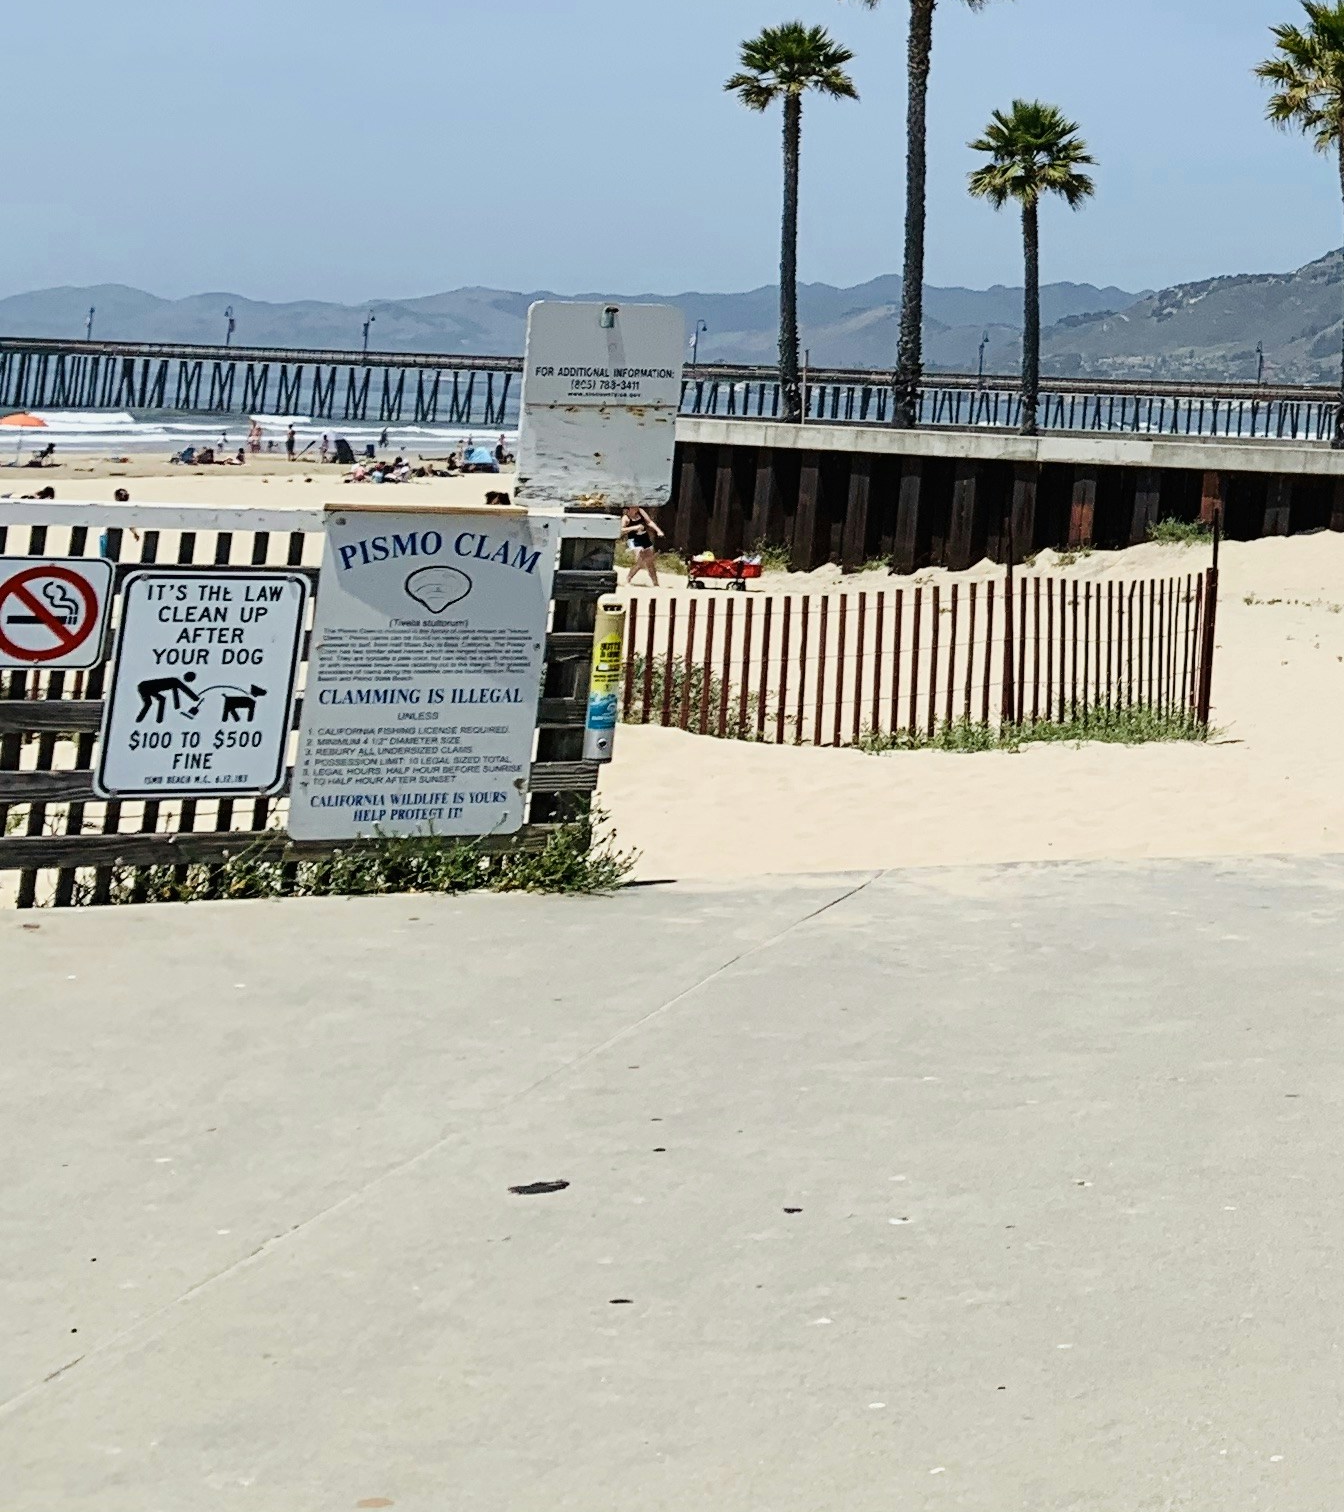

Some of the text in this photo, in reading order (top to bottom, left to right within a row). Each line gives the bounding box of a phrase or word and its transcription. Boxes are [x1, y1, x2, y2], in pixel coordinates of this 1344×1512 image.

[536, 367, 675, 379] FOR ADDITIONAL INFORMATION:
[571, 379, 595, 390] (805)
[338, 531, 543, 574] PISMO CLAM
[148, 585, 283, 602] IT'S THE LAW
[159, 606, 268, 623] CLEAN UP
[176, 628, 244, 644] AFTER
[153, 649, 264, 665] YOUR DOG
[319, 688, 523, 704] CLAMMING IS ILLEGAL
[378, 727, 415, 735] FISHING
[418, 726, 458, 734] LICENSE
[129, 729, 262, 751] $100 TO $500
[390, 737, 438, 745] DIAMETER
[316, 748, 355, 756] REBURY
[359, 748, 375, 756] ALL
[378, 747, 438, 755] UNDERSIZED
[173, 754, 214, 769] FINE
[421, 757, 450, 765] LEGAL
[443, 766, 481, 774] BEFORE
[483, 765, 522, 773] SUNRISE
[385, 776, 416, 784] AFTER
[310, 792, 507, 808] CALIFORNIA WILDLIFE IS YOURS
[353, 810, 386, 822] HELP
[391, 808, 442, 821] PROTECT
